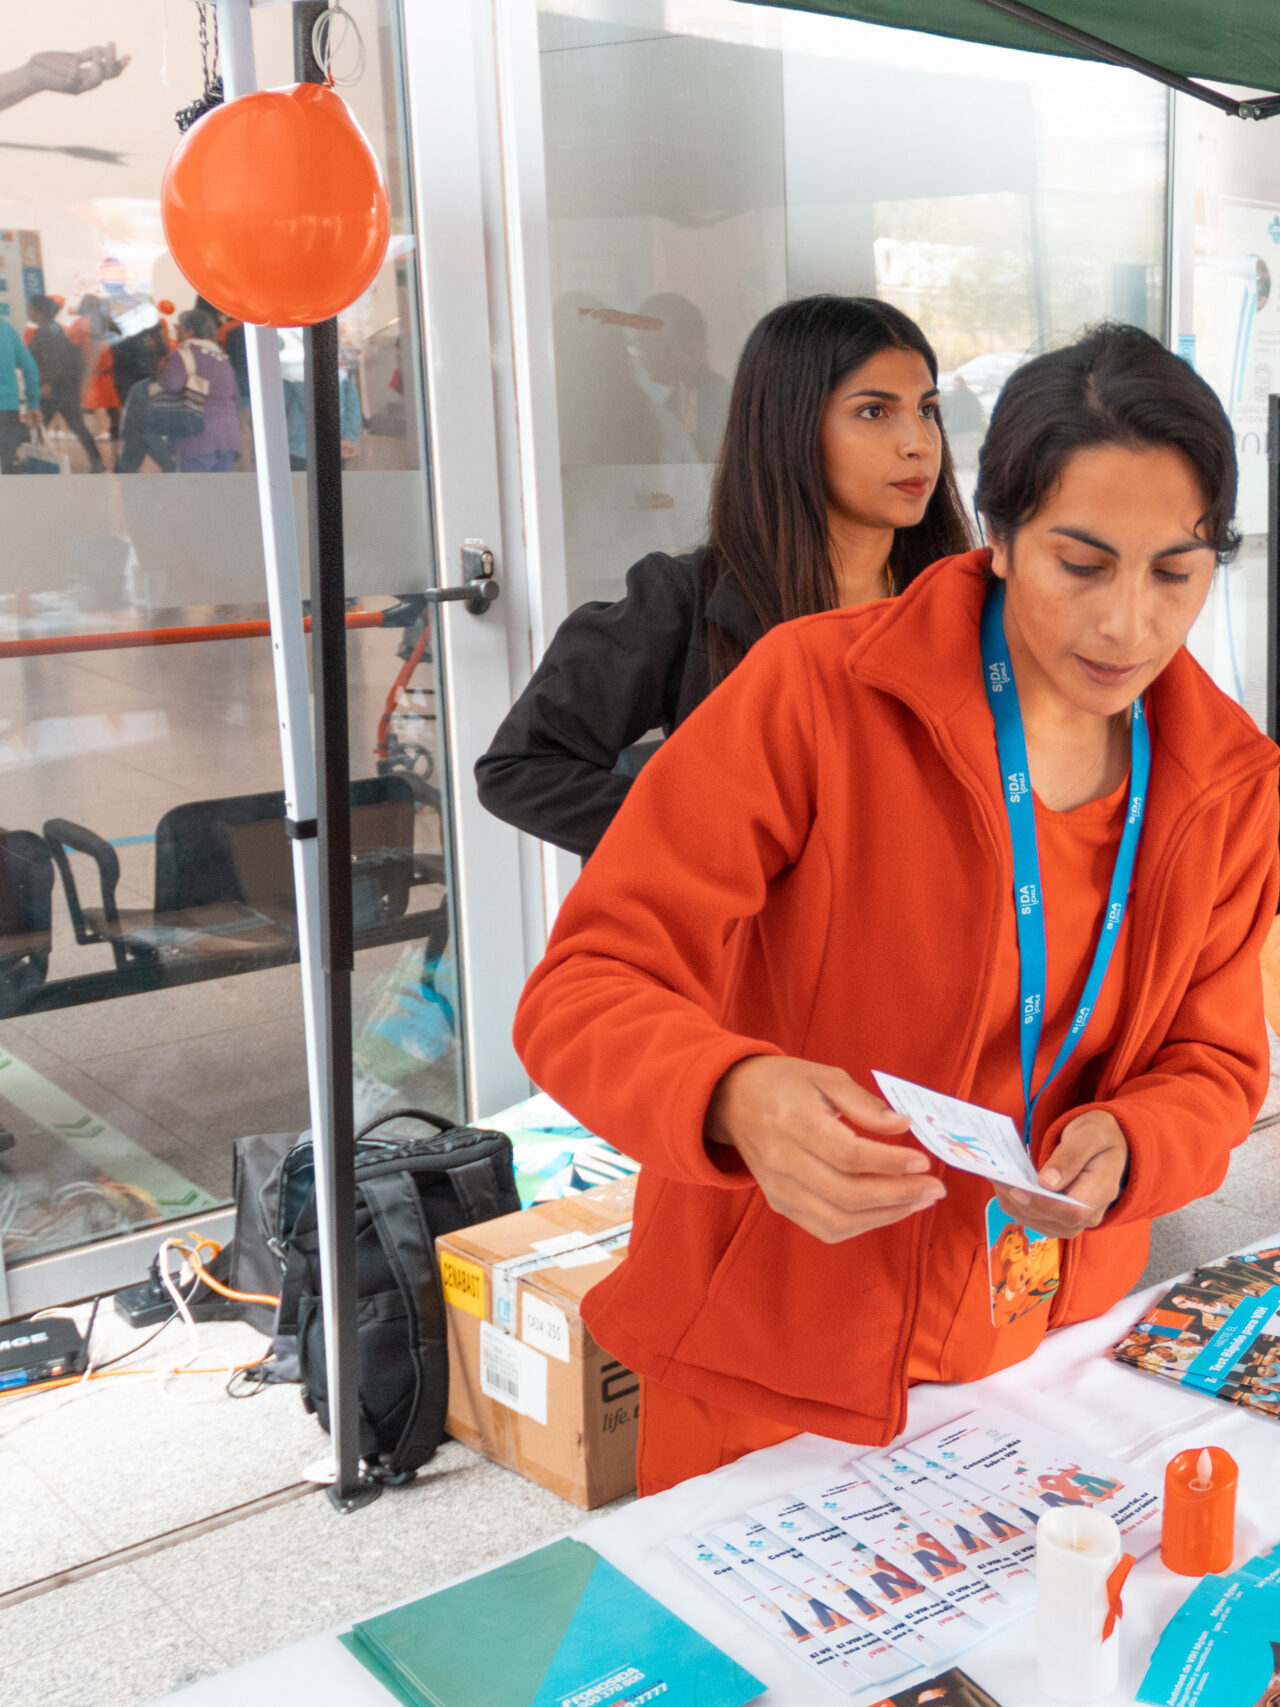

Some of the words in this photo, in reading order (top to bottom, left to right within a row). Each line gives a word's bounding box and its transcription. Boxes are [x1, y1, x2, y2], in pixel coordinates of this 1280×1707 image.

[1008, 773, 1020, 803] SIDA
[1020, 885, 1031, 915] SIDA
[443, 1262, 480, 1299] CENABAST
[1208, 1355, 1228, 1372] Test
[1242, 1317, 1260, 1336] para
[1254, 1305, 1269, 1320] VIH
[571, 1667, 640, 1703] FONOSIDA
